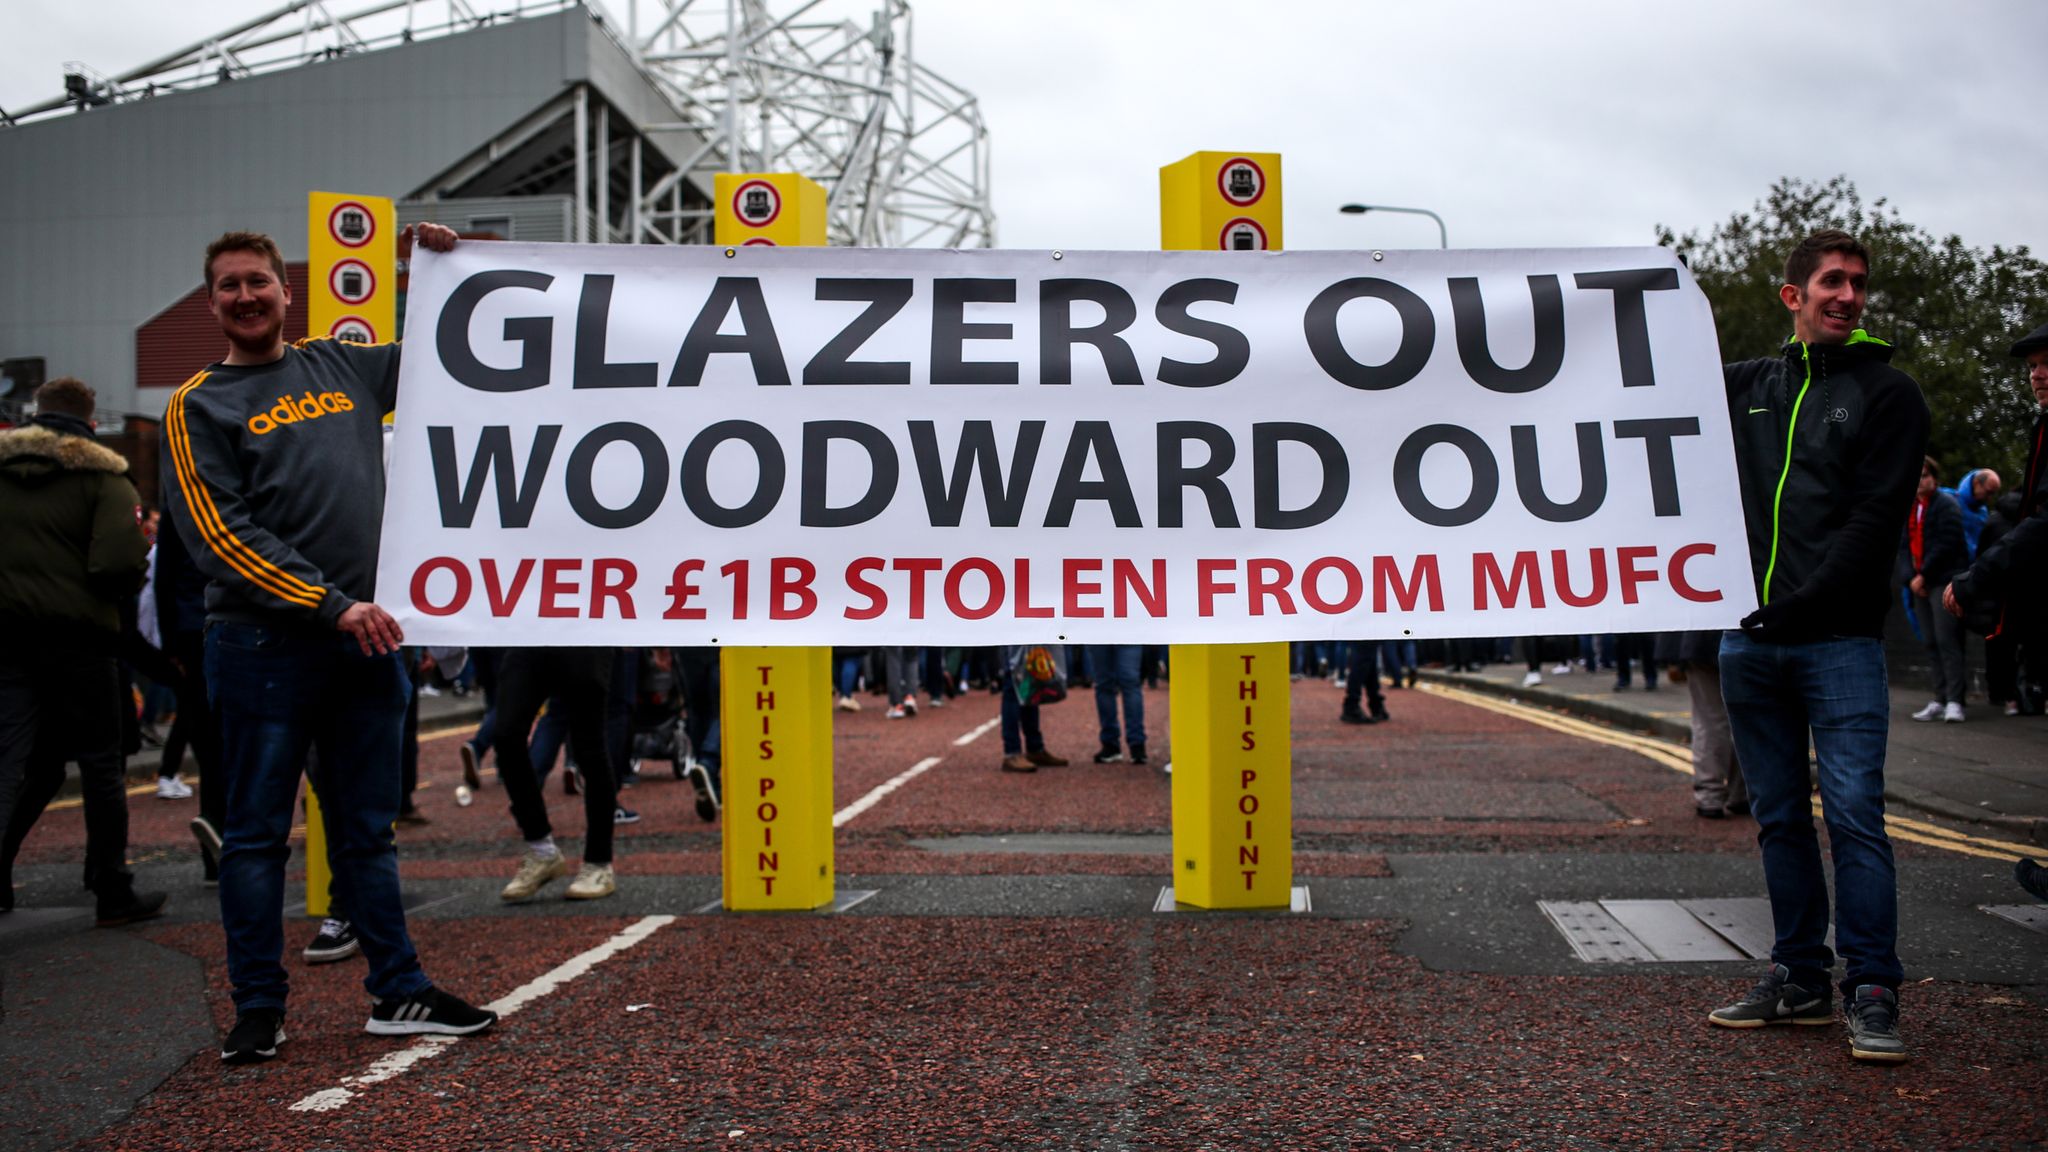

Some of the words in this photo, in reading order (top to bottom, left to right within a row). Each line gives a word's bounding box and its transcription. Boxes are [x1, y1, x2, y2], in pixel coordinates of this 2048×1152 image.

[436, 270, 1250, 392] GLAZERS
[1304, 268, 1680, 393] OUT
[248, 390, 354, 435] adidas
[427, 420, 1349, 529] WOODWARD
[1393, 417, 1700, 527] OUT
[411, 556, 637, 619] OVER
[664, 557, 817, 620] £1B
[844, 557, 1167, 620] STOLEN
[1198, 555, 1444, 617] FROM
[1473, 544, 1722, 610] MUFC
[756, 666, 775, 760] THIS
[1238, 655, 1258, 751] THIS
[757, 778, 779, 896] POINT
[1238, 769, 1260, 891] POINT
